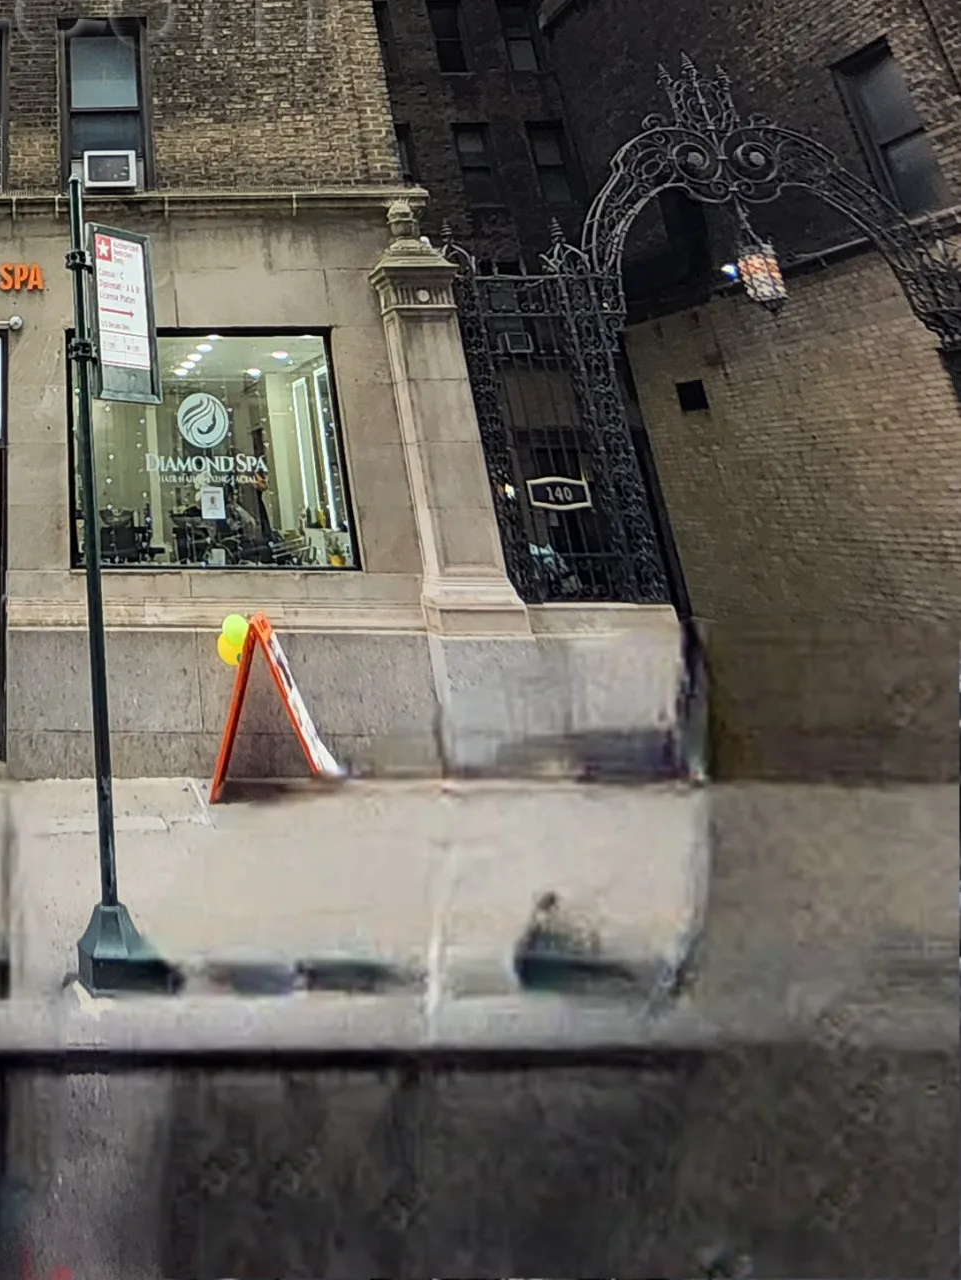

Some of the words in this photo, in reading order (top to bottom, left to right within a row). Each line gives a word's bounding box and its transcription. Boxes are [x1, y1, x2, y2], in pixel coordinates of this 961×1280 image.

[145, 453, 235, 473] DIAMOND
[236, 453, 269, 473] SPA
[545, 486, 573, 502] 140
